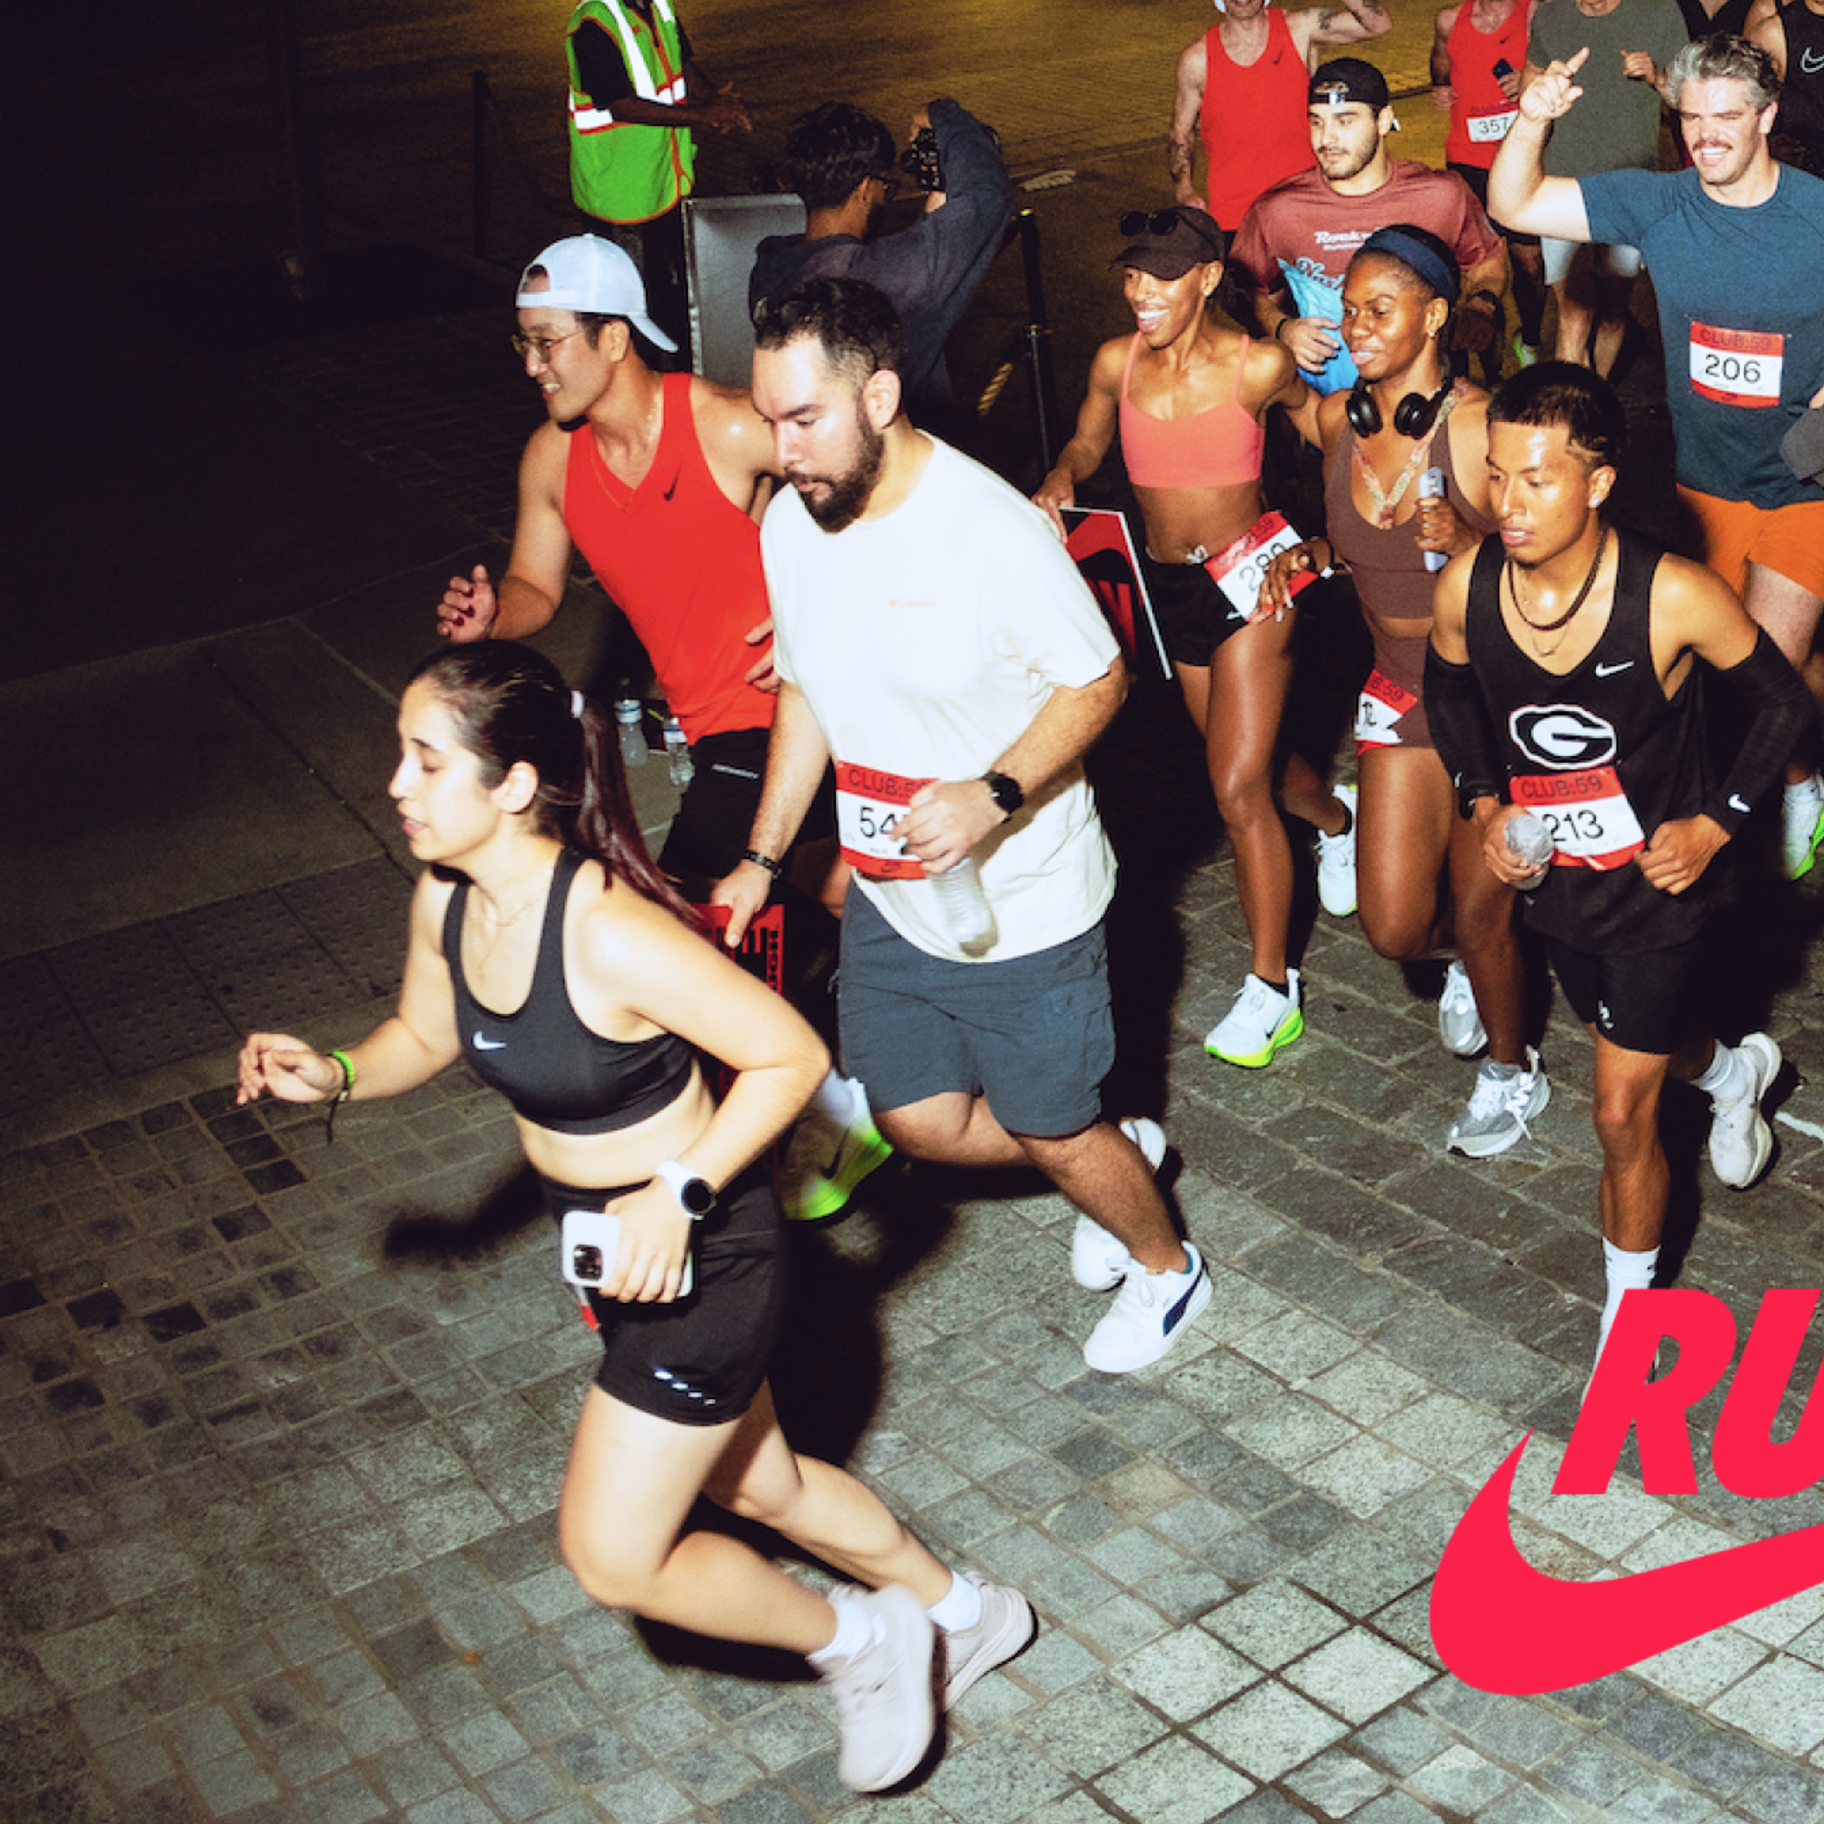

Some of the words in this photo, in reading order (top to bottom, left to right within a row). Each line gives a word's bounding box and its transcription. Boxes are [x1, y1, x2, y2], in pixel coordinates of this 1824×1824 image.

[1479, 116, 1509, 134] 357
[1701, 329, 1771, 350] CLUB:59
[1705, 353, 1761, 384] 206
[1509, 704, 1618, 770] G
[849, 768, 928, 797] CLUB:5
[1521, 775, 1603, 798] CLUB:59
[860, 804, 906, 839] 54
[1542, 810, 1604, 841] 213
